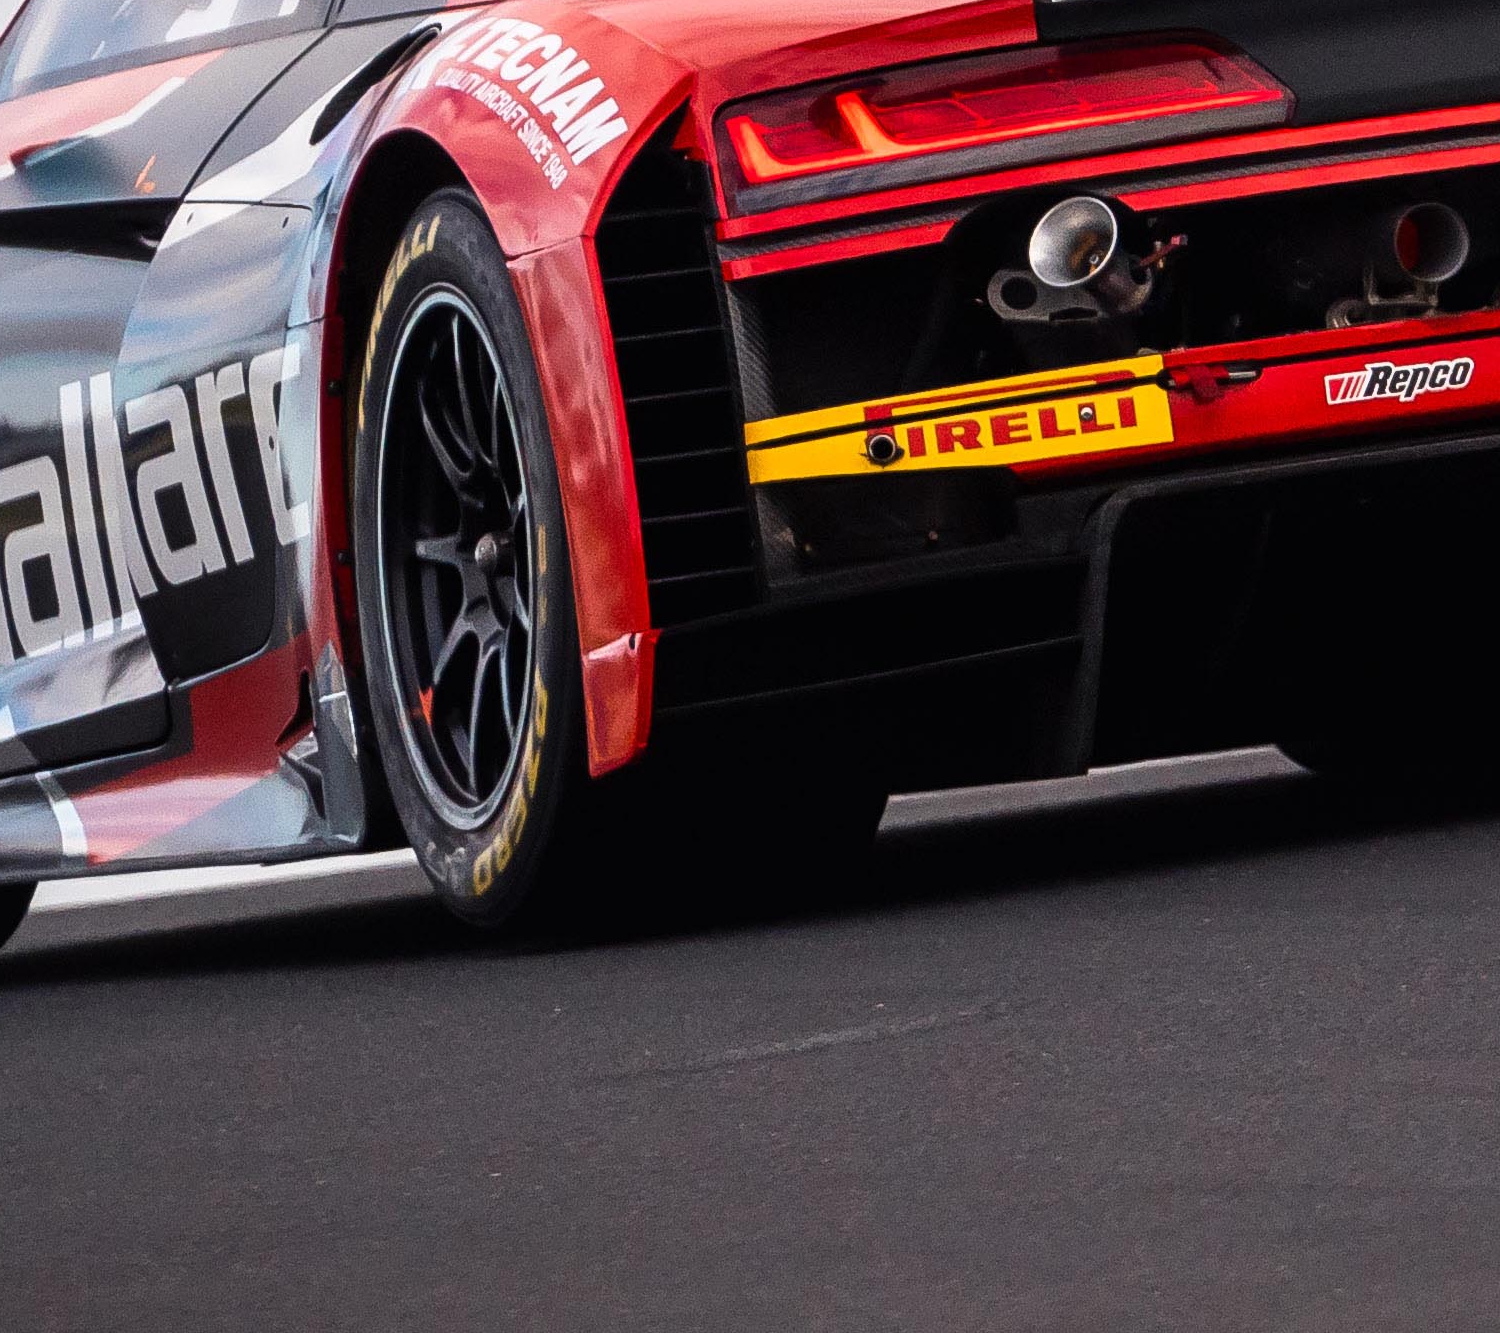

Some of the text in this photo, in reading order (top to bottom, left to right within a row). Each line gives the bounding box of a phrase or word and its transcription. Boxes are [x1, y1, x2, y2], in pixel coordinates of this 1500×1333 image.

[457, 15, 629, 166] TECNAM
[516, 117, 554, 164] SINCE
[1364, 359, 1473, 400] Repco
